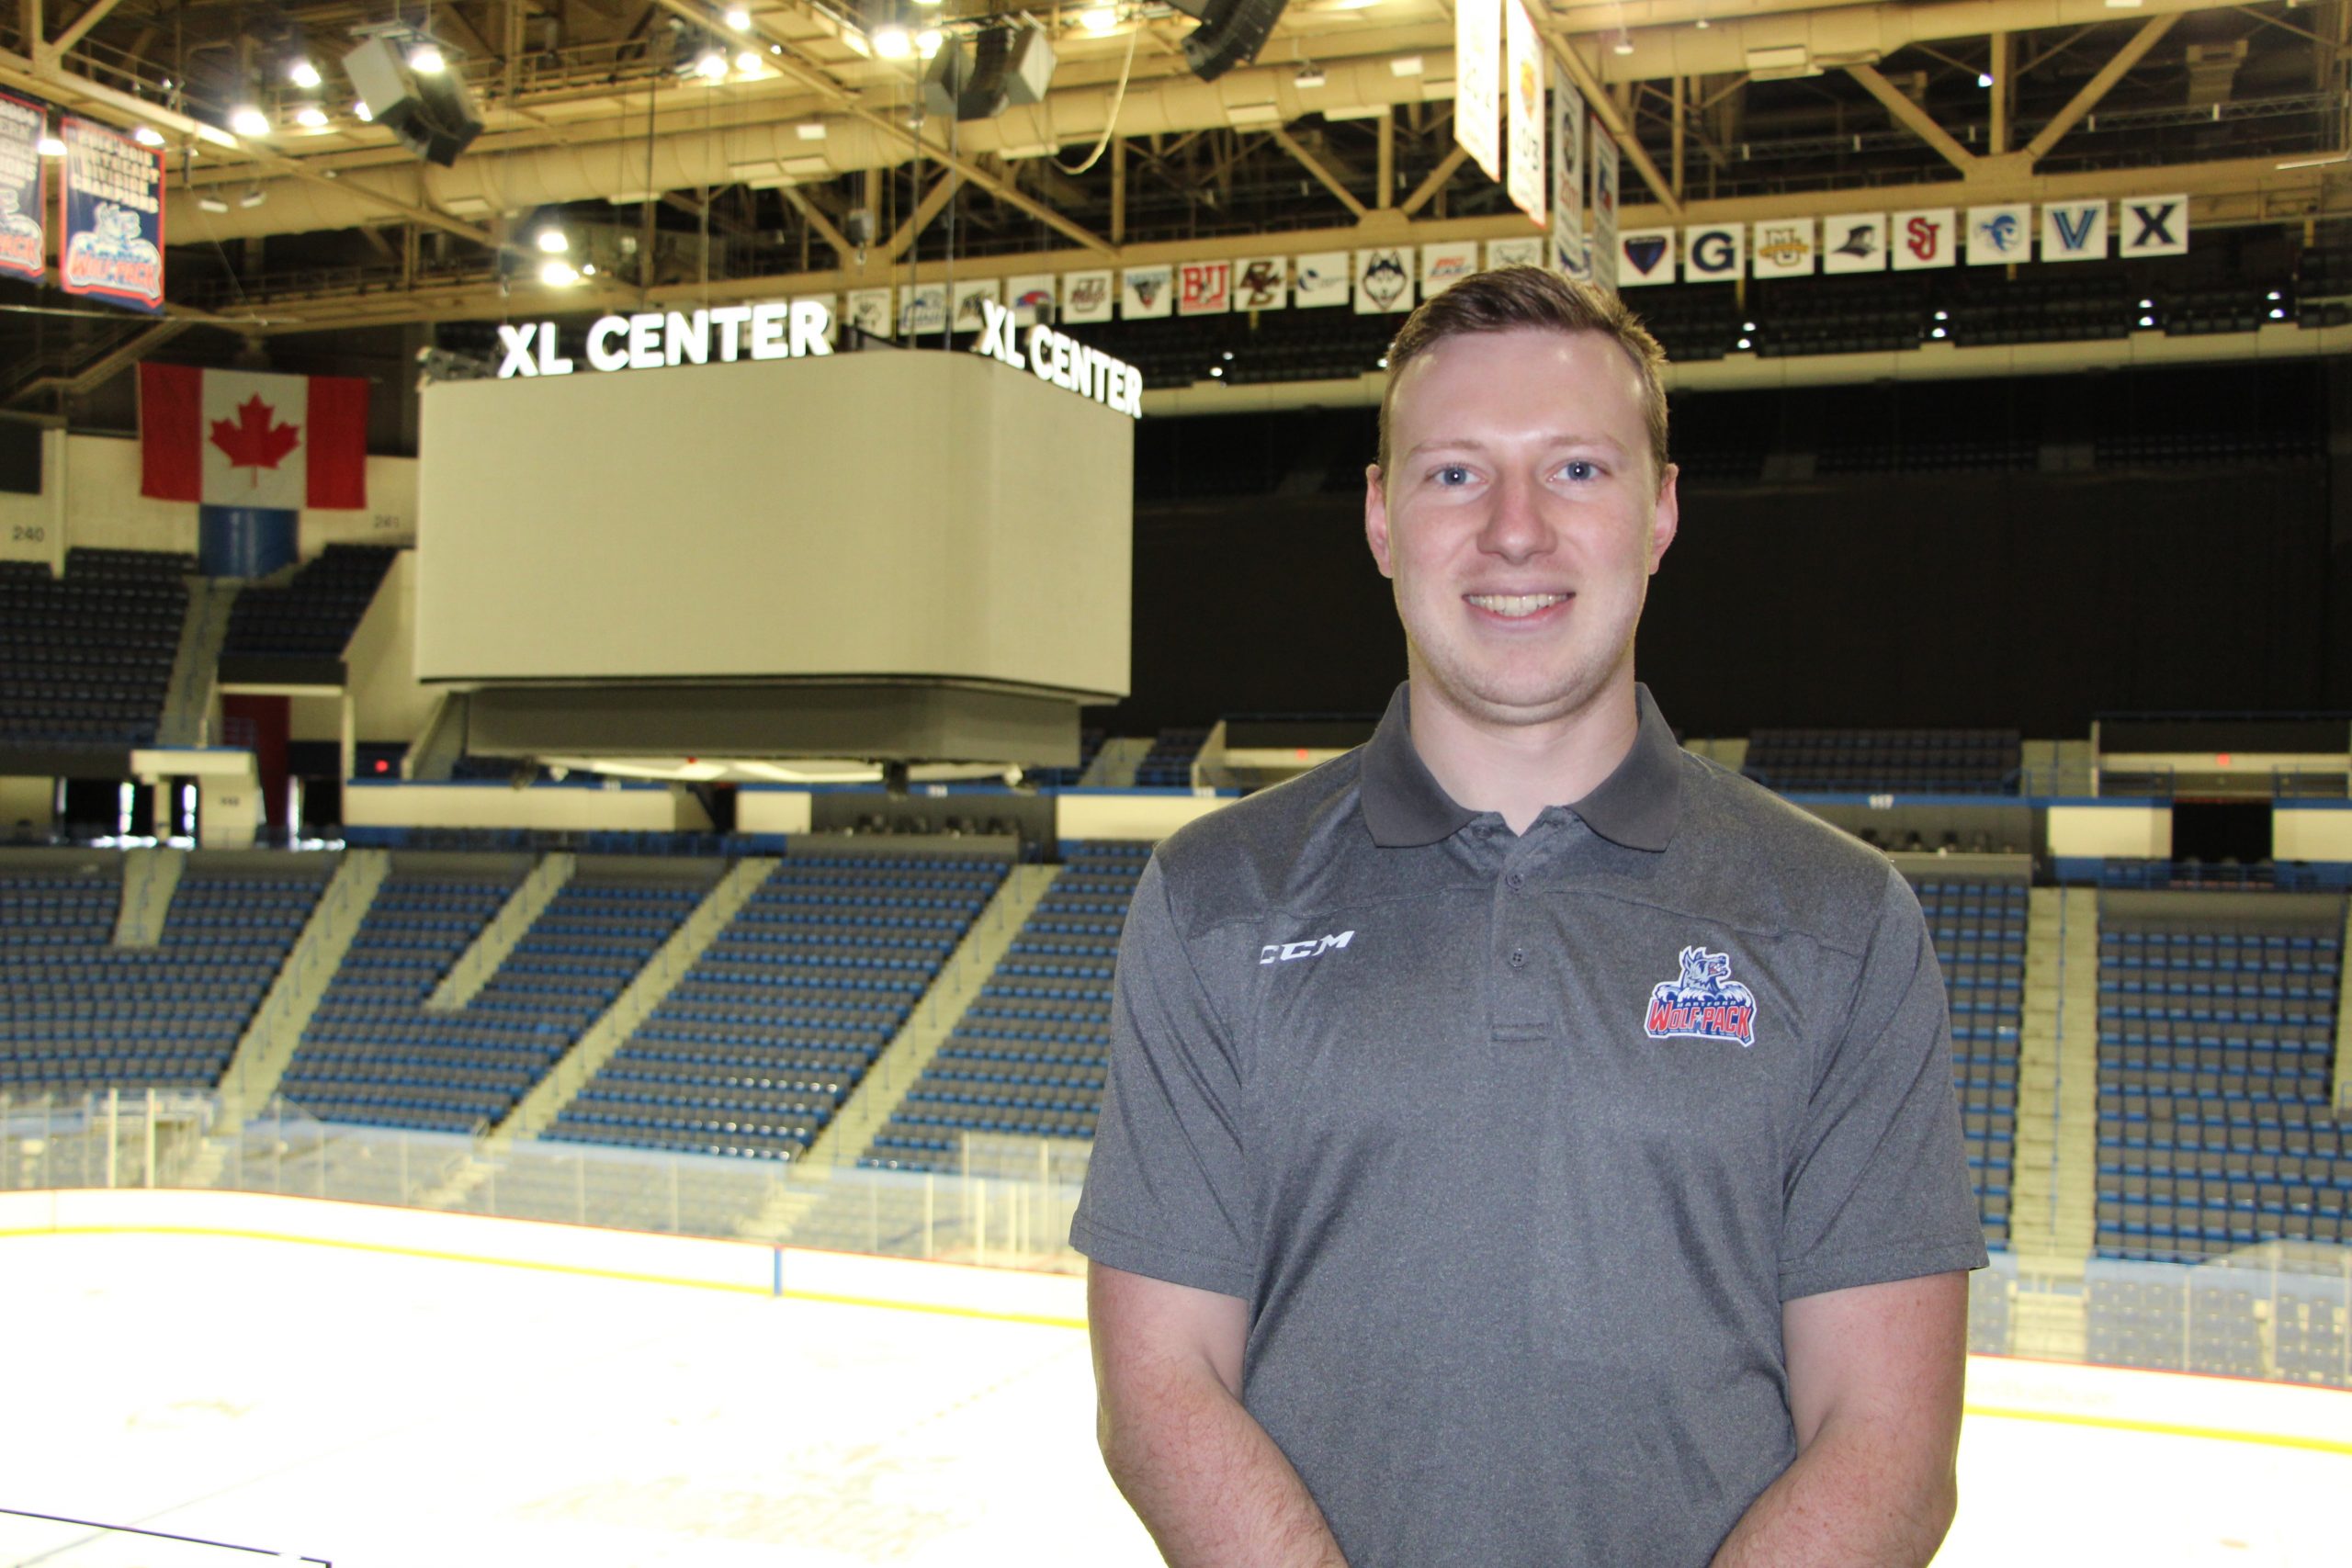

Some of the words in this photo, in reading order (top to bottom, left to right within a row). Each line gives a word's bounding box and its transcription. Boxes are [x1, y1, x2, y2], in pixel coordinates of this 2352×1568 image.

[2051, 206, 2098, 252] V
[2129, 201, 2178, 248] X
[1691, 231, 1735, 274] G
[497, 321, 574, 379] XL
[586, 300, 832, 372] CENTER
[979, 299, 1025, 370] XL
[1030, 324, 1143, 419] CENTER
[1259, 931, 1355, 964] CCM
